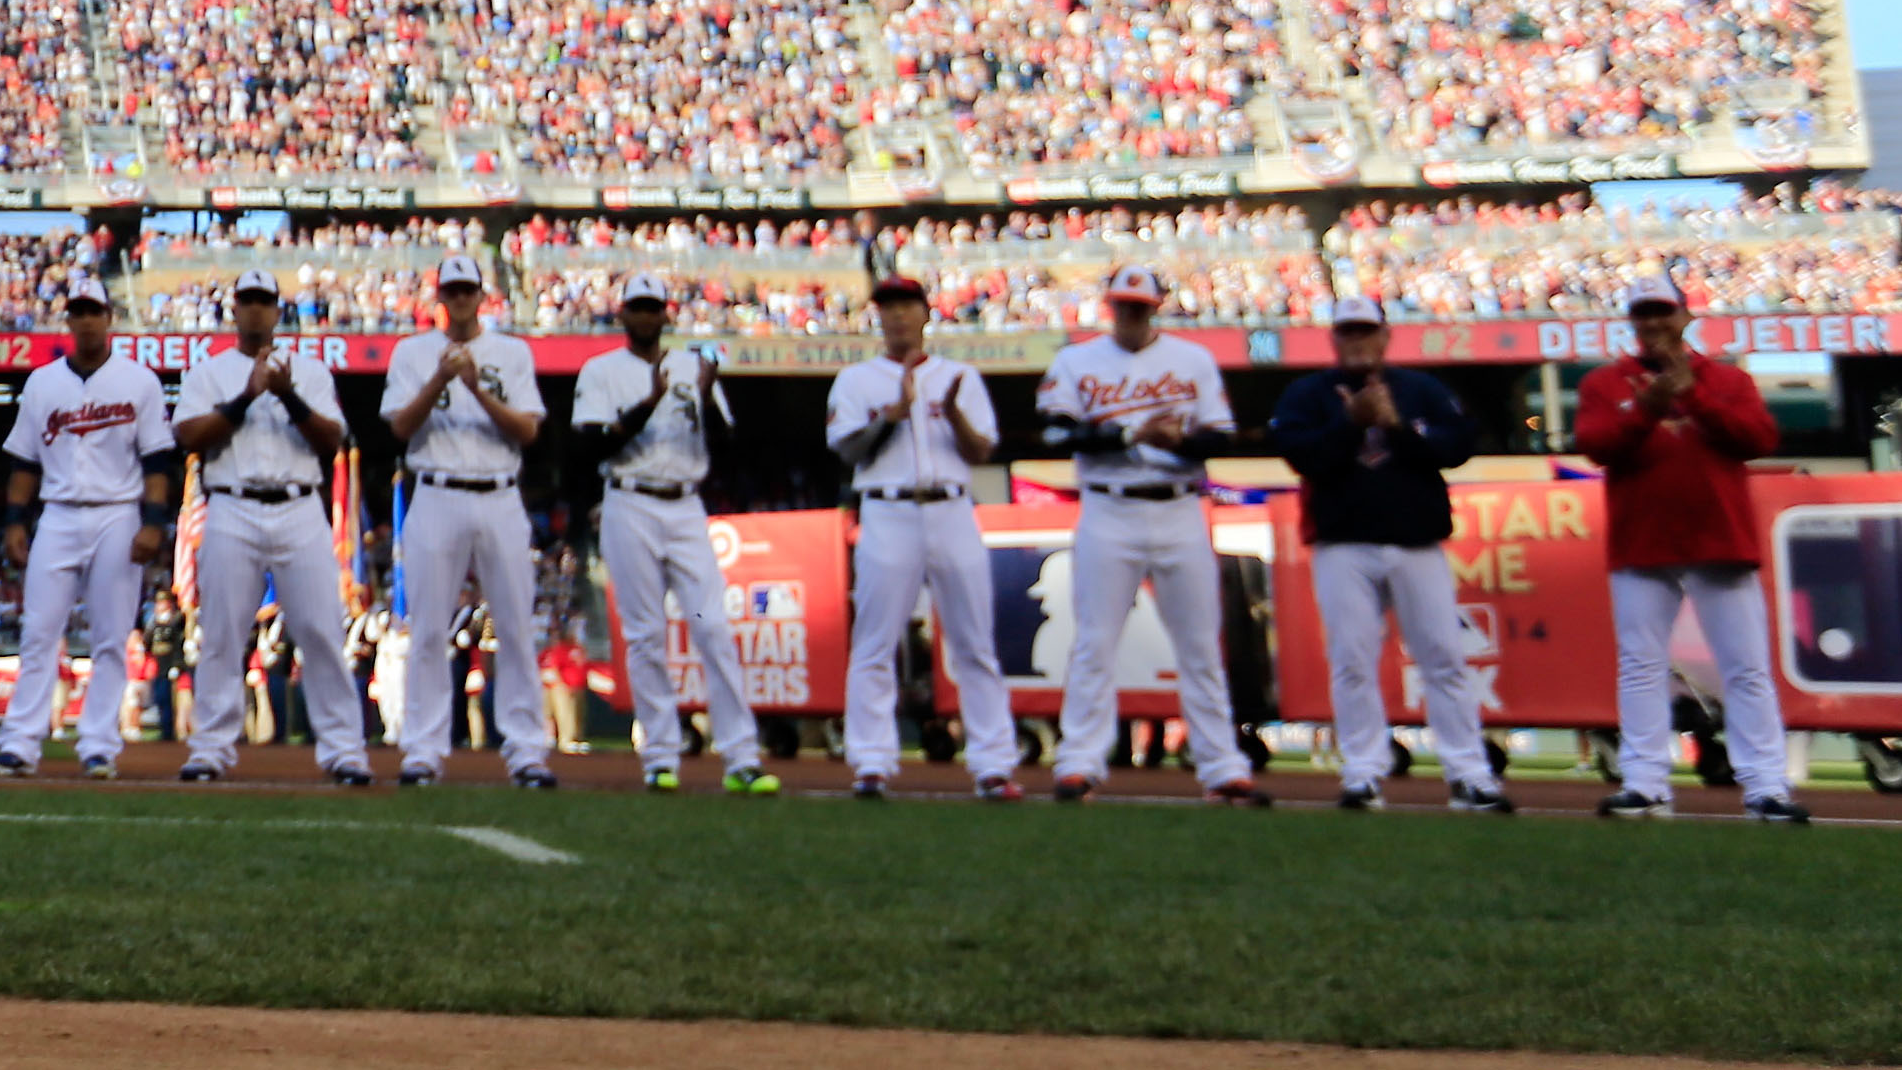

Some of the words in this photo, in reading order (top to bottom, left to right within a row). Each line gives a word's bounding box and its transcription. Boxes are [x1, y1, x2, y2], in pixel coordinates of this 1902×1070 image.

[1422, 325, 1472, 358] #2
[1722, 316, 1890, 354] JETER
[43, 400, 137, 446] Indians
[728, 621, 807, 664] TAR
